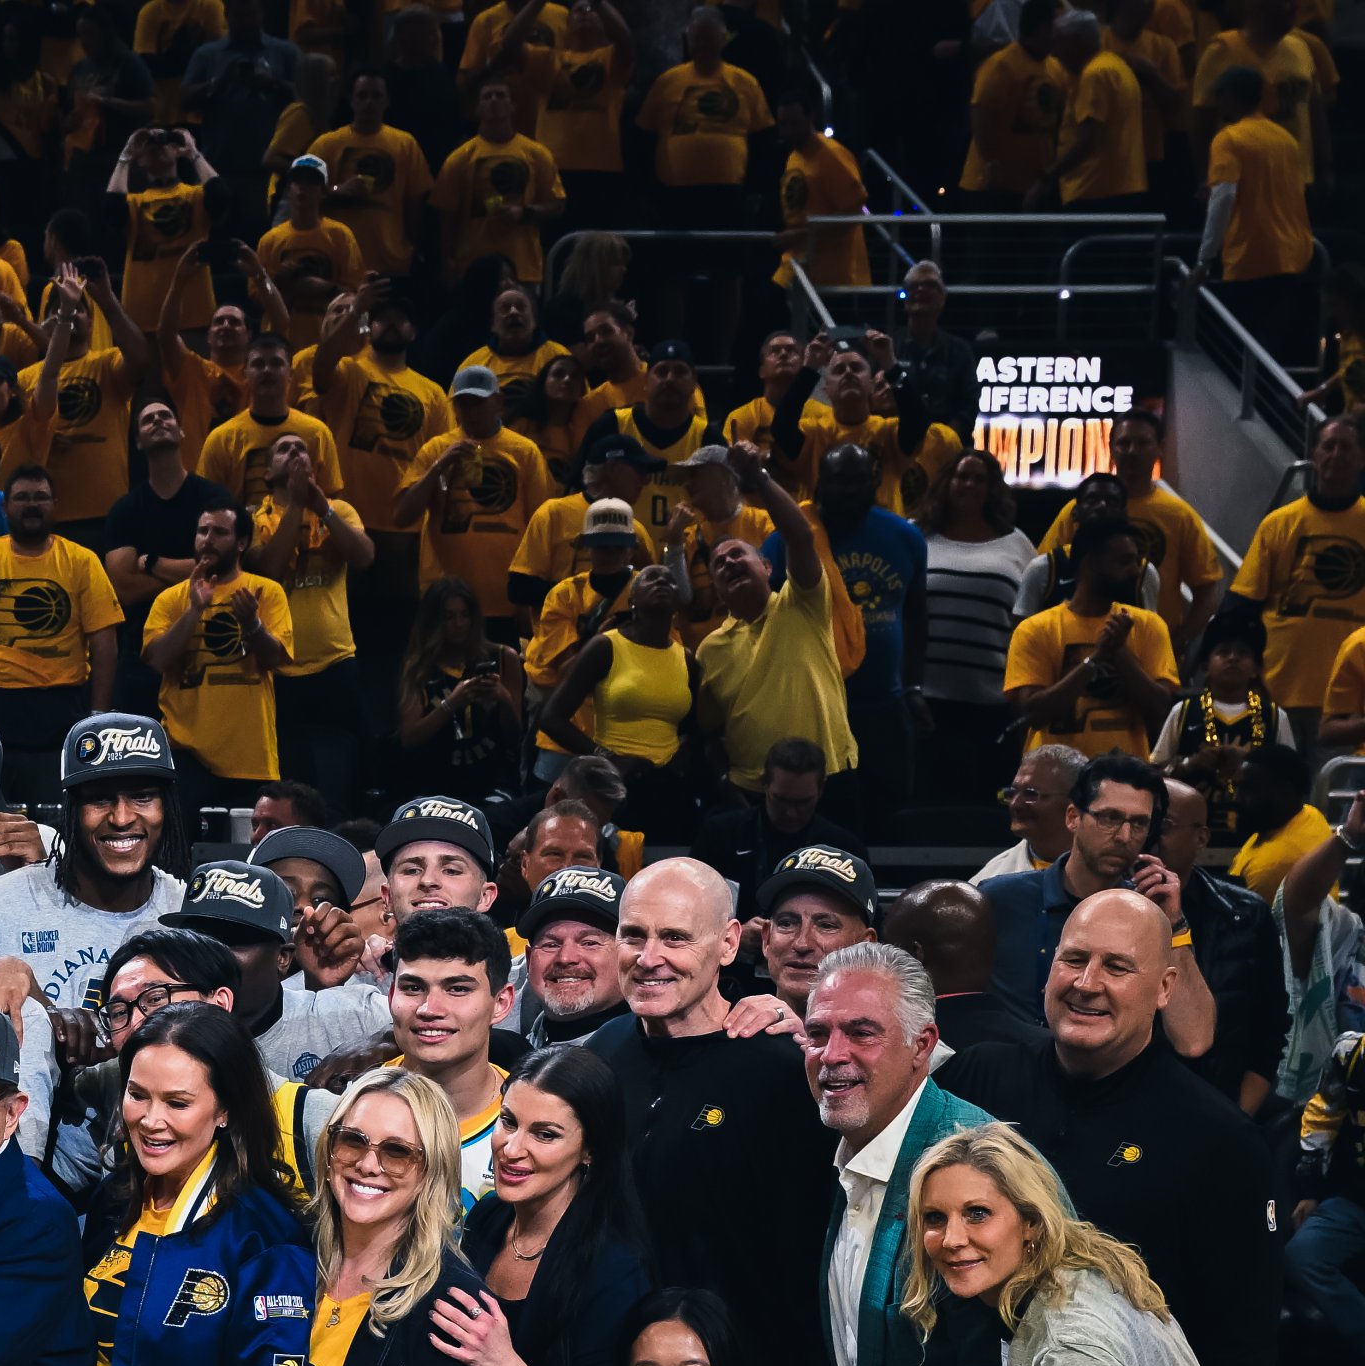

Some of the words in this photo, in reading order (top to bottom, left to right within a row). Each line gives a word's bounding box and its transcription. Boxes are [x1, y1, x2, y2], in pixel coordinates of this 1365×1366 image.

[976, 356, 1101, 383] ASTERN
[979, 385, 1133, 412] FERENCE
[972, 415, 1117, 487] MPION
[837, 552, 903, 592] NAPOLIS
[91, 727, 161, 765] Finals
[798, 848, 857, 883] Finals
[193, 868, 265, 908] Finals
[551, 869, 617, 902] Finals
[44, 946, 110, 1003] DIANA
